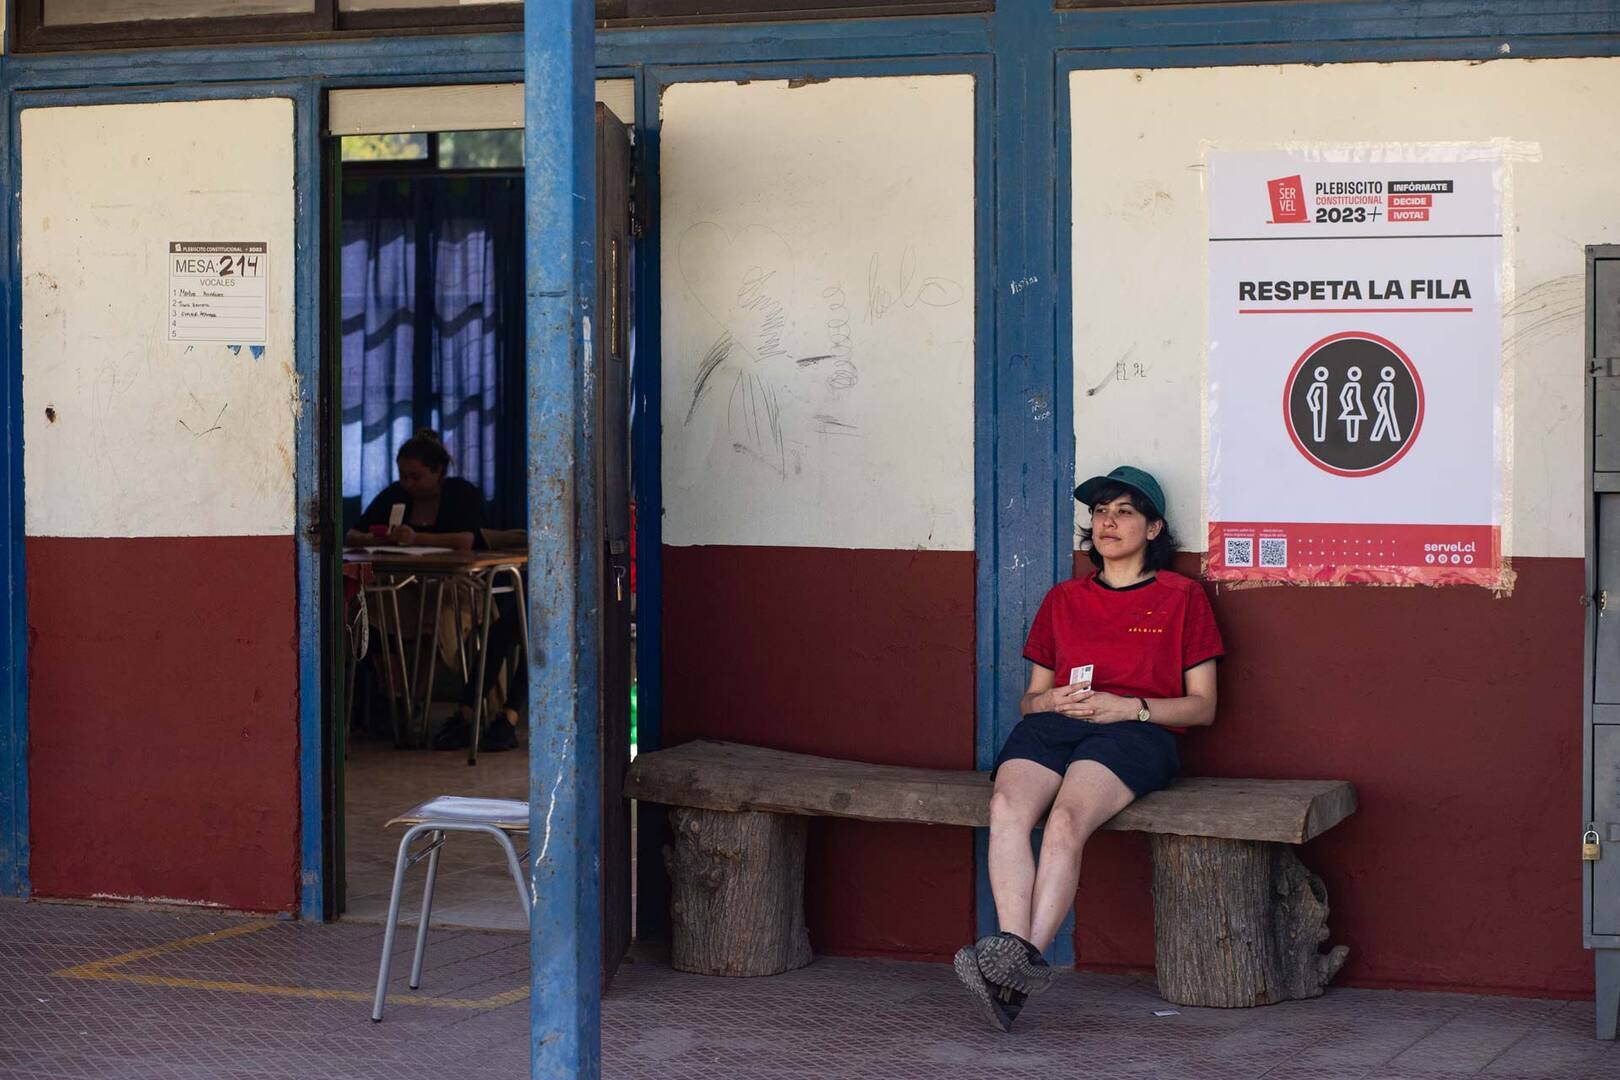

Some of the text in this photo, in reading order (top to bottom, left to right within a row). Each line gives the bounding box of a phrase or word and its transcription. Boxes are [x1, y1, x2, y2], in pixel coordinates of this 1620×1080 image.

[1315, 181, 1383, 195] PLEBISCITO
[1393, 182, 1448, 192] INFÓRMATE
[1279, 187, 1297, 200] SER
[1279, 200, 1297, 212] VEL
[1315, 195, 1383, 206] CONSTITUCIONAL
[1393, 197, 1427, 206] DECIDE
[175, 255, 258, 277] MESA: 214
[200, 279, 235, 287] VOCALES
[1239, 279, 1472, 301] RESPETA LA FILA
[1424, 541, 1476, 552] servel.cl
